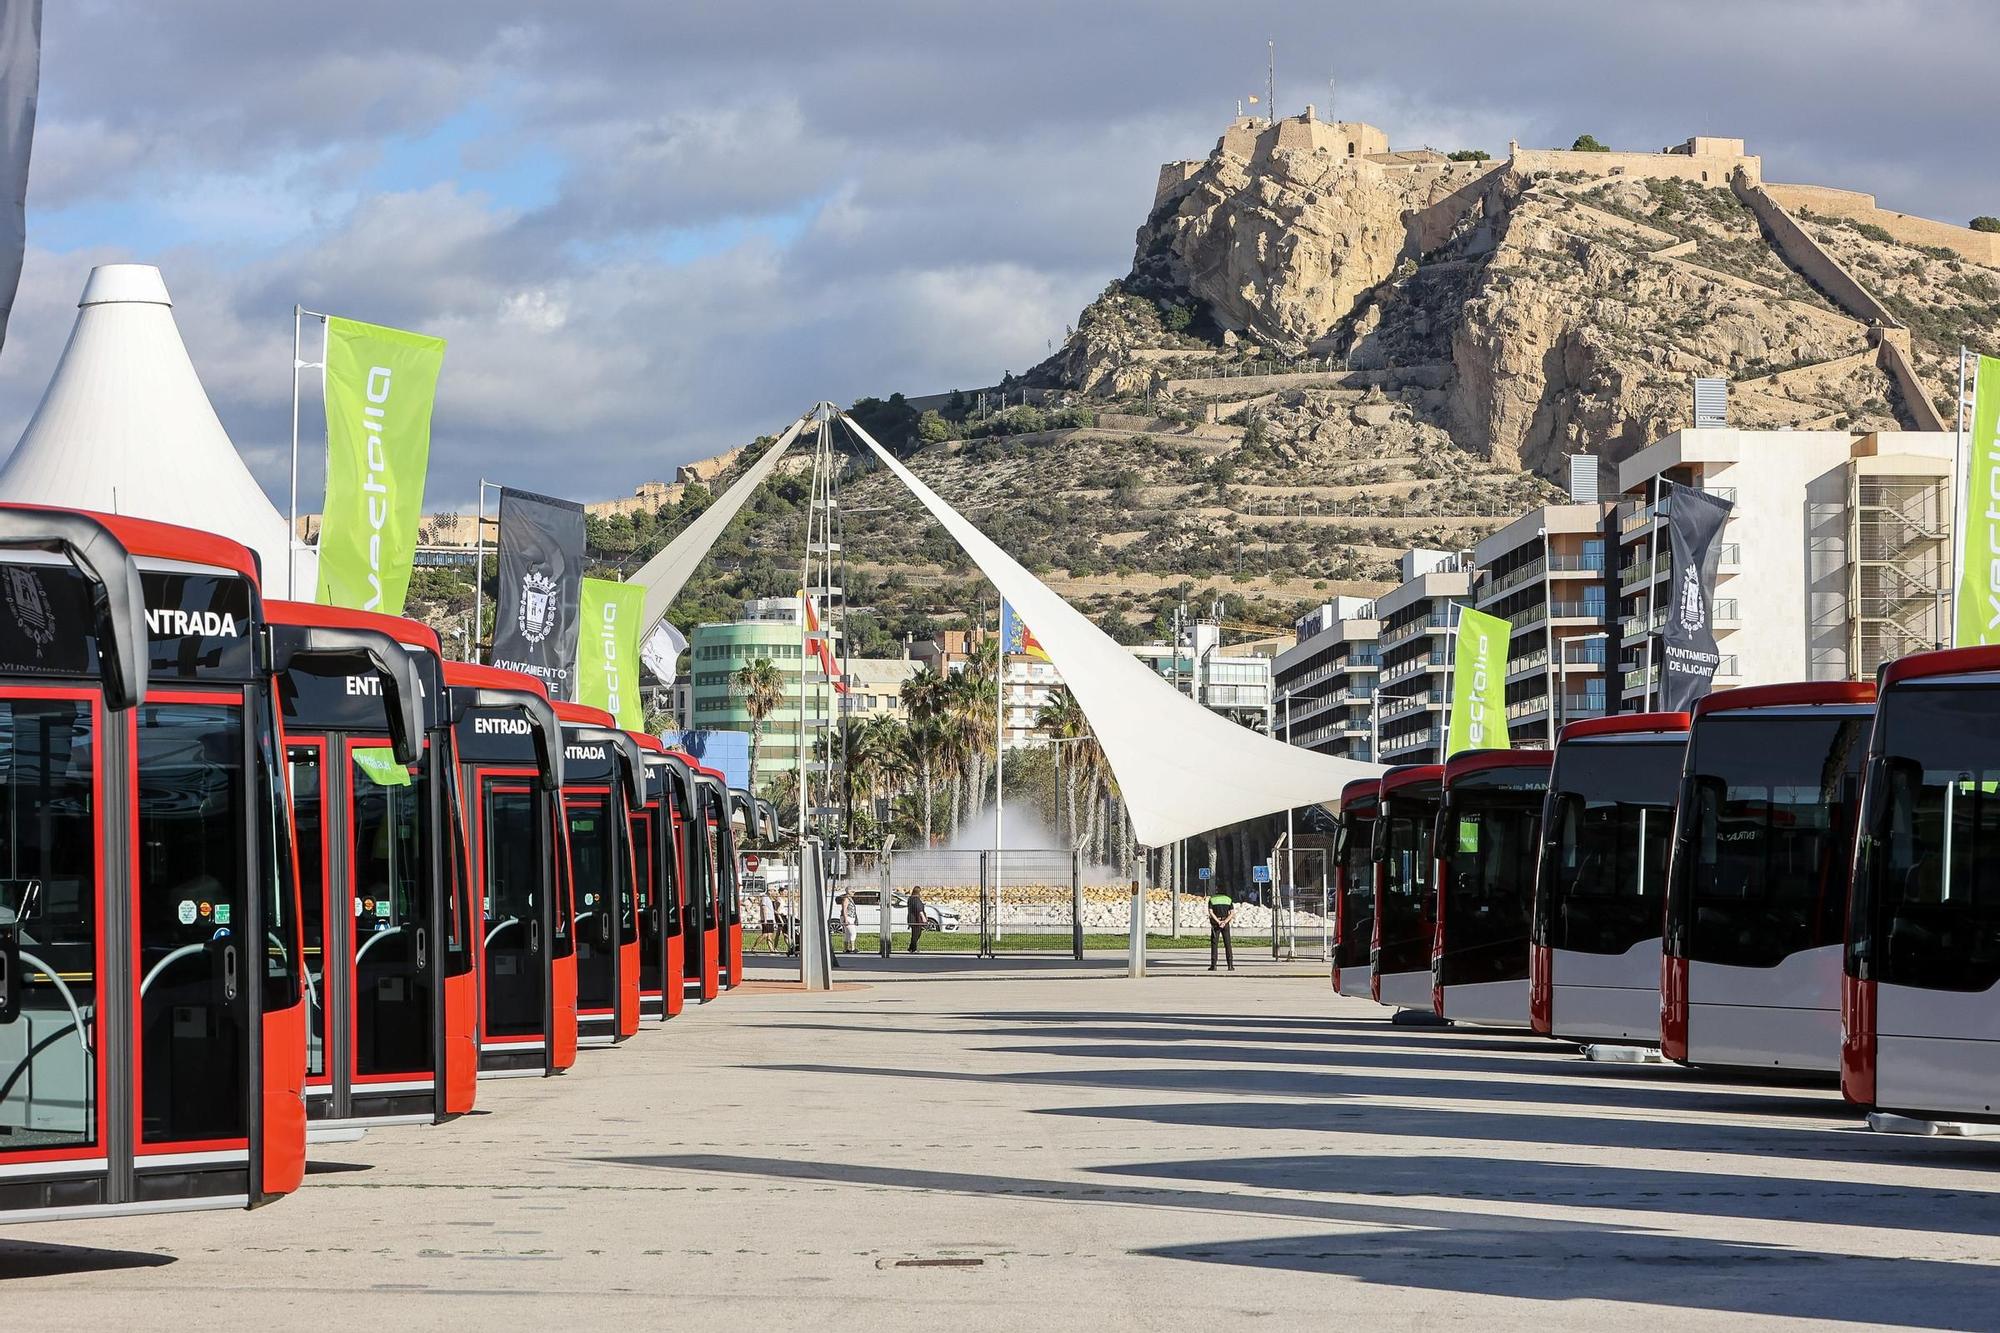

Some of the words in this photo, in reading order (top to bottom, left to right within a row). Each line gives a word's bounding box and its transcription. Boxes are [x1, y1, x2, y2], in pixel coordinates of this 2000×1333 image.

[363, 366, 392, 610] vectalia
[1985, 414, 2000, 630] vectali
[143, 609, 237, 638] NTRADA
[1665, 645, 1719, 664] AYUNTAMIENTO
[601, 602, 620, 728] ectalia
[1469, 636, 1488, 750] ectalia
[1669, 660, 1681, 672] DE
[1682, 663, 1714, 677] ALICANT
[563, 746, 606, 760] NTRADA
